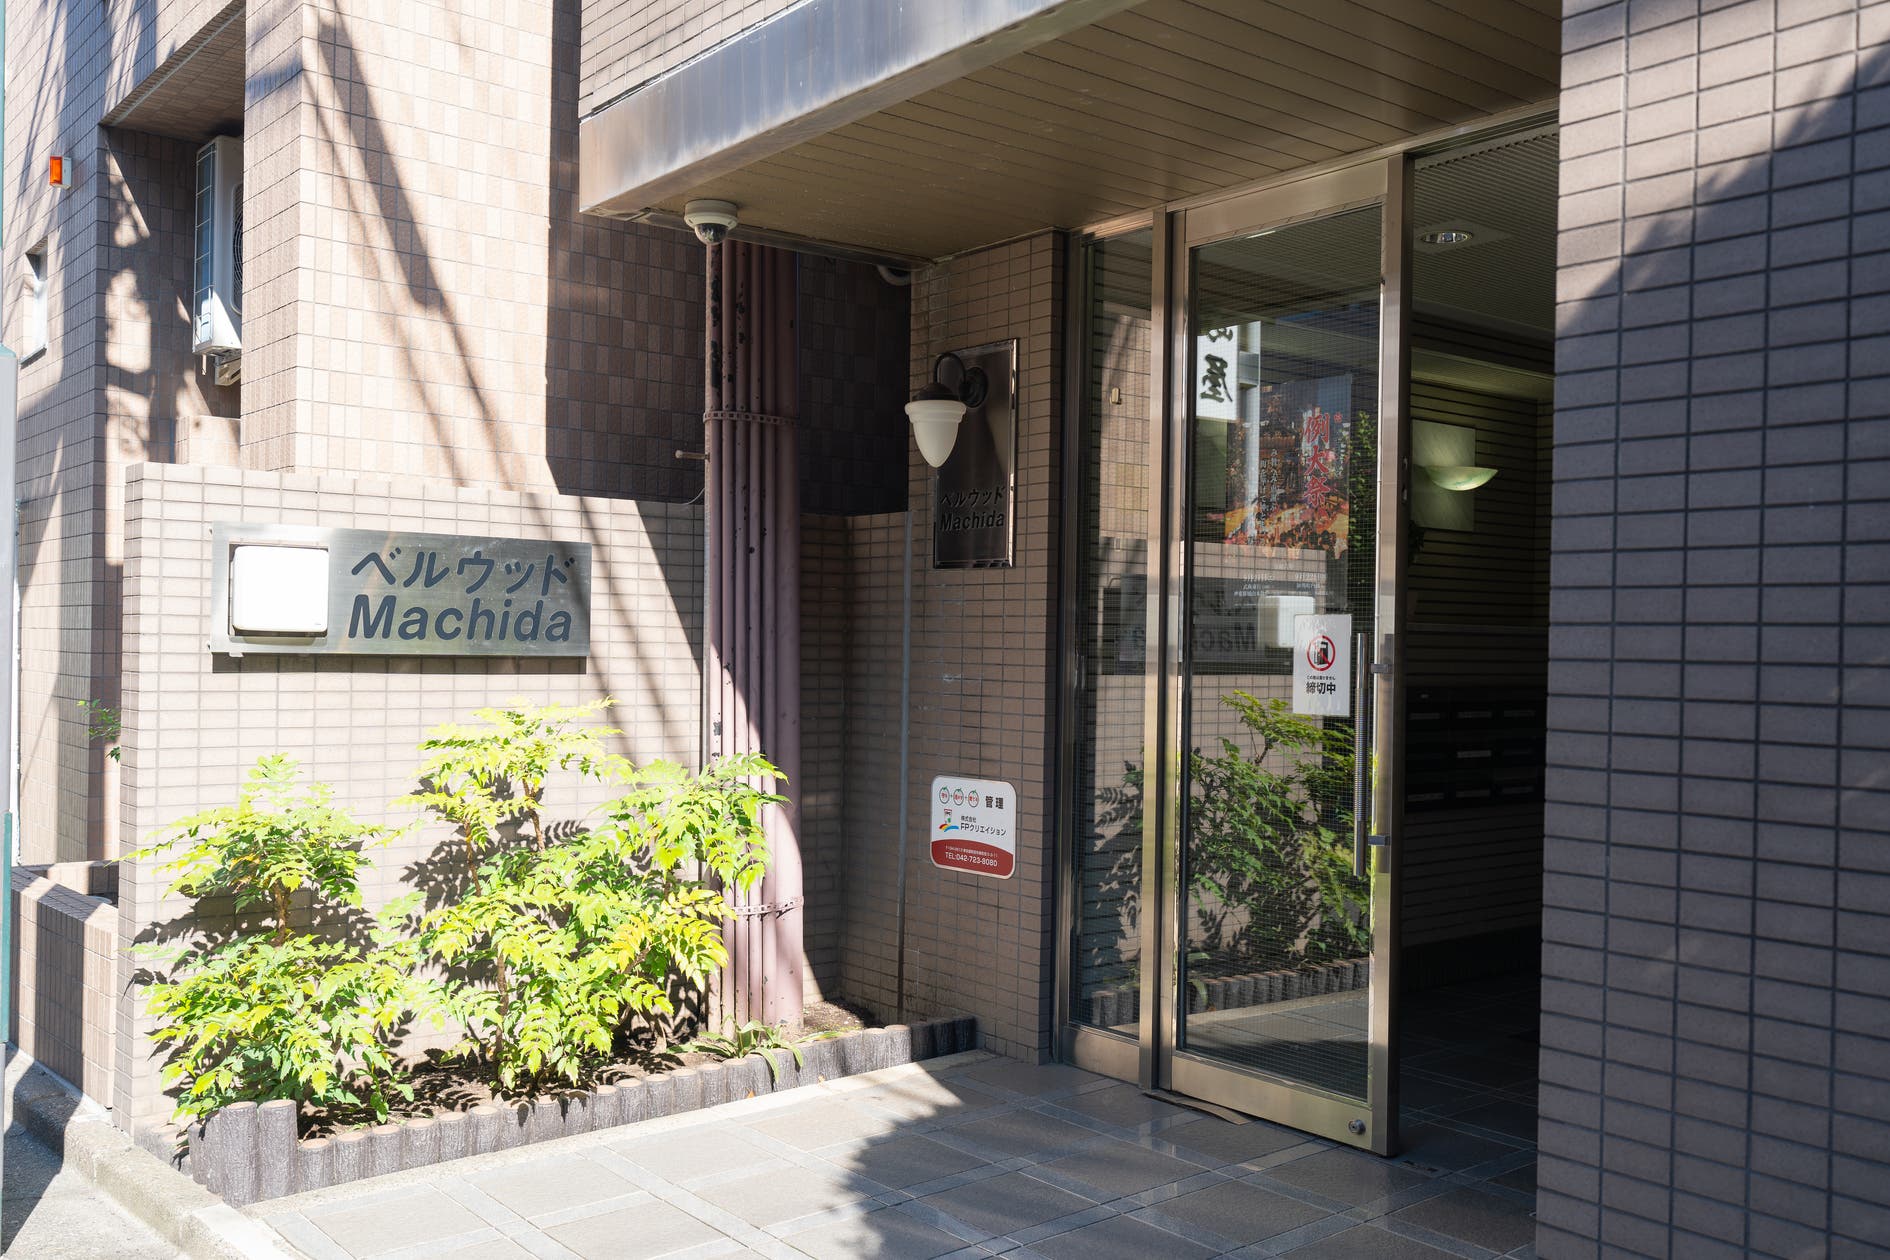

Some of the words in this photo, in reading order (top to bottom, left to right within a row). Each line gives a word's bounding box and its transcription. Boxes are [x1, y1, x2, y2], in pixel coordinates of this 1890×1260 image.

[1304, 413, 1331, 507] 例大祭
[941, 510, 1005, 531] Machida
[350, 547, 576, 596] ベルウッド
[347, 594, 572, 642] Machida
[1305, 682, 1336, 695] 締切中
[985, 796, 1004, 809] 管理
[960, 822, 1007, 836] FPクリエイション
